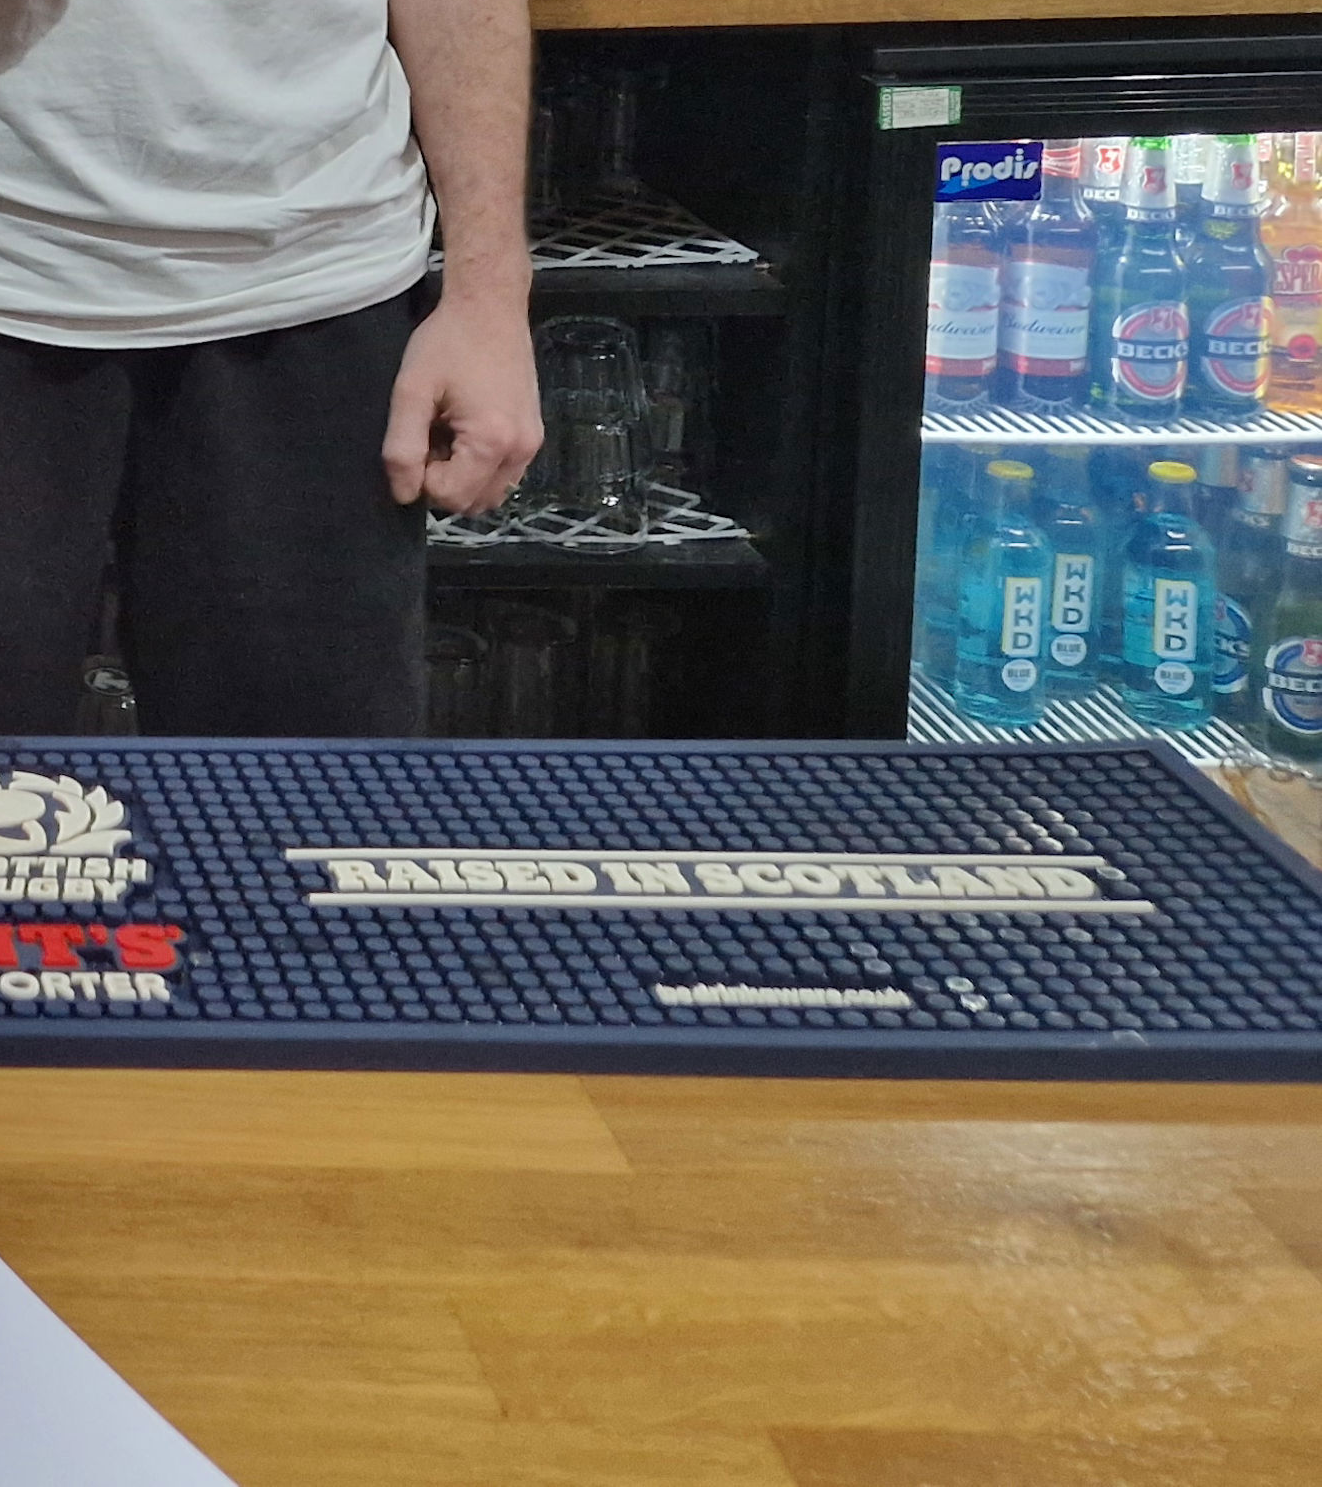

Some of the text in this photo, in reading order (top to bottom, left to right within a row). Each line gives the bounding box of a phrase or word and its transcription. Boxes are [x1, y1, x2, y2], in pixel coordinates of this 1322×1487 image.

[941, 147, 1039, 187] Prodis
[929, 319, 997, 336] udweiser
[1063, 562, 1087, 627] WKD
[1013, 584, 1035, 651] WKD
[1164, 587, 1189, 652] WKD
[1056, 642, 1083, 655] BLUE
[1007, 667, 1033, 681] BLUE
[1159, 669, 1188, 683] BLUE
[325, 858, 1100, 900] RAISED IN SCOTLAND
